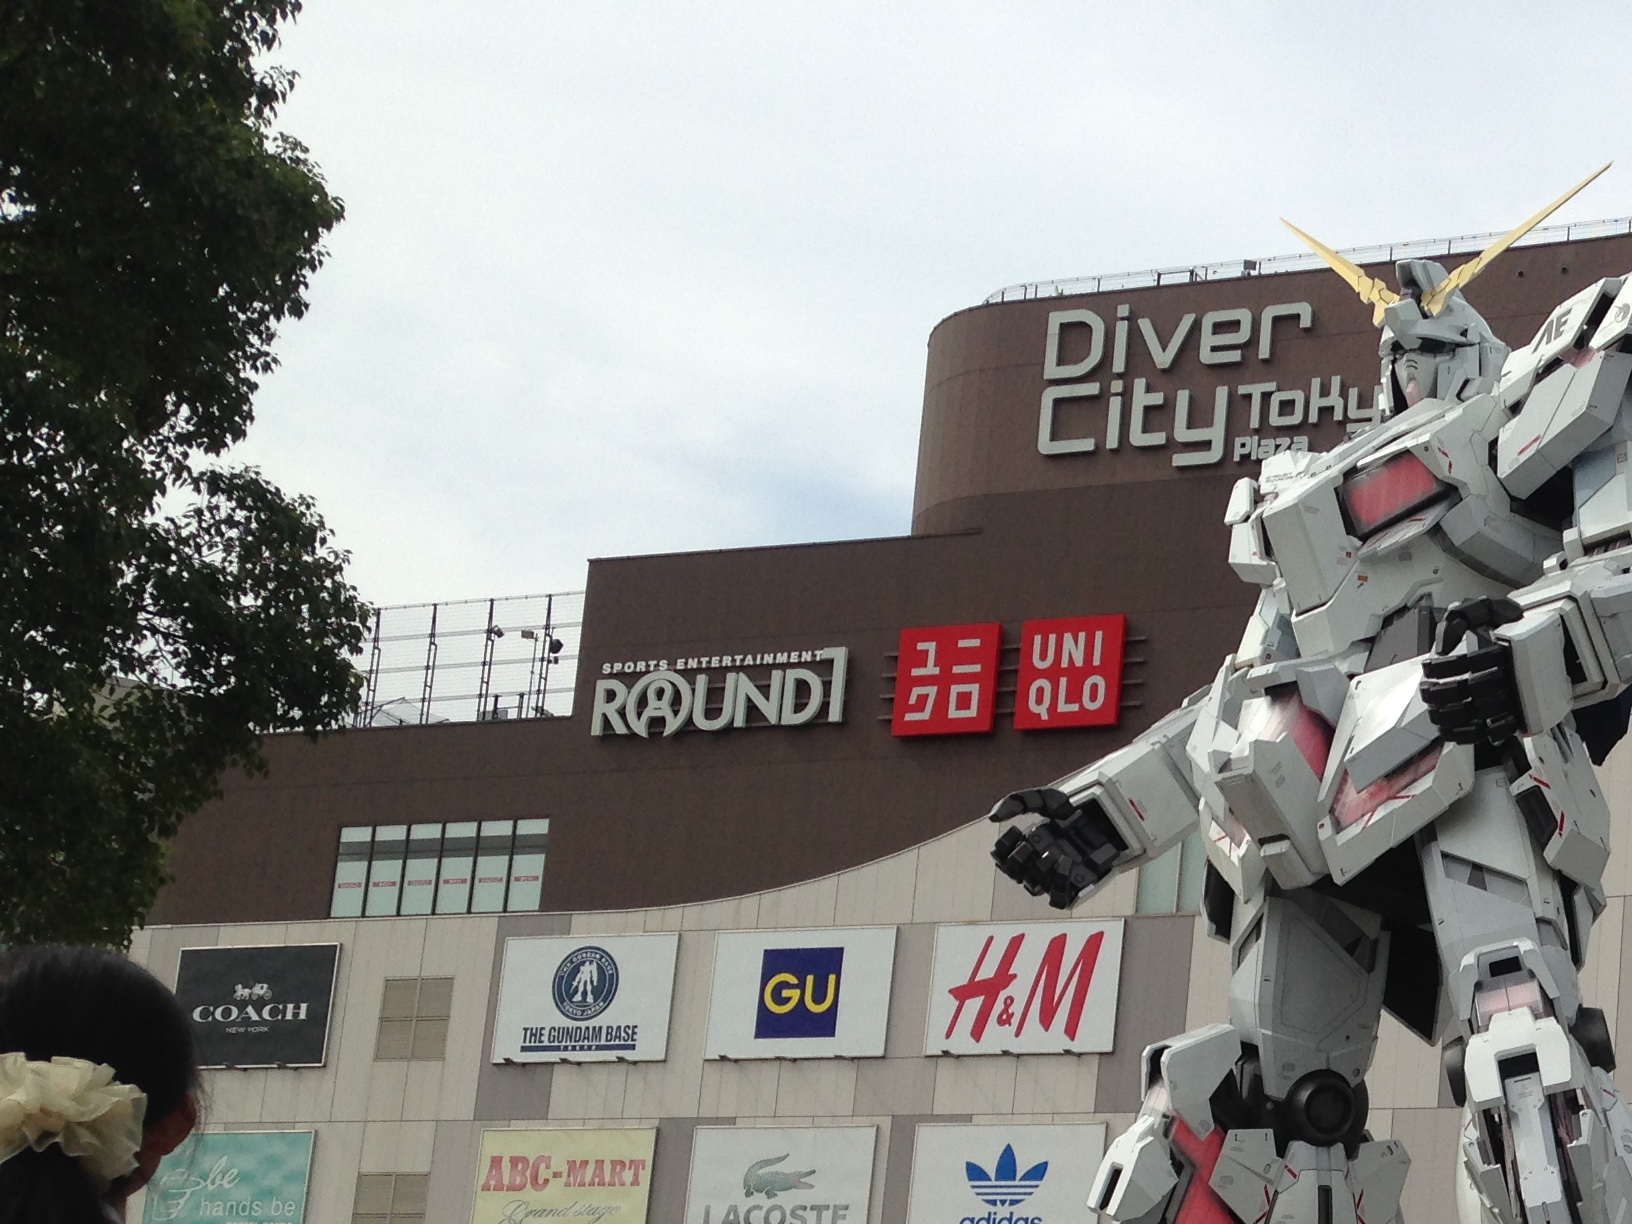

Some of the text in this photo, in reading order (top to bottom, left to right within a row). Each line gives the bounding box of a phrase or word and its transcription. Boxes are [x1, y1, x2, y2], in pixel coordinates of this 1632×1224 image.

[1043, 302, 1314, 380] Diver
[1037, 377, 1229, 467] City
[1233, 435, 1308, 462] Plaza
[602, 649, 824, 674] SPORTS ENTERTAINMENT
[911, 638, 982, 676] ユニ
[1032, 631, 1103, 669] UNI
[904, 684, 980, 721] クロ
[1028, 675, 1106, 720] QLO
[763, 972, 836, 1014] GU
[945, 931, 1104, 1043] H&M
[192, 1002, 309, 1022] COACH
[522, 1025, 638, 1044] THE GUNDAM BASE
[206, 1155, 240, 1190] be
[481, 1155, 646, 1192] ABC-MART
[200, 1196, 296, 1216] hands be
